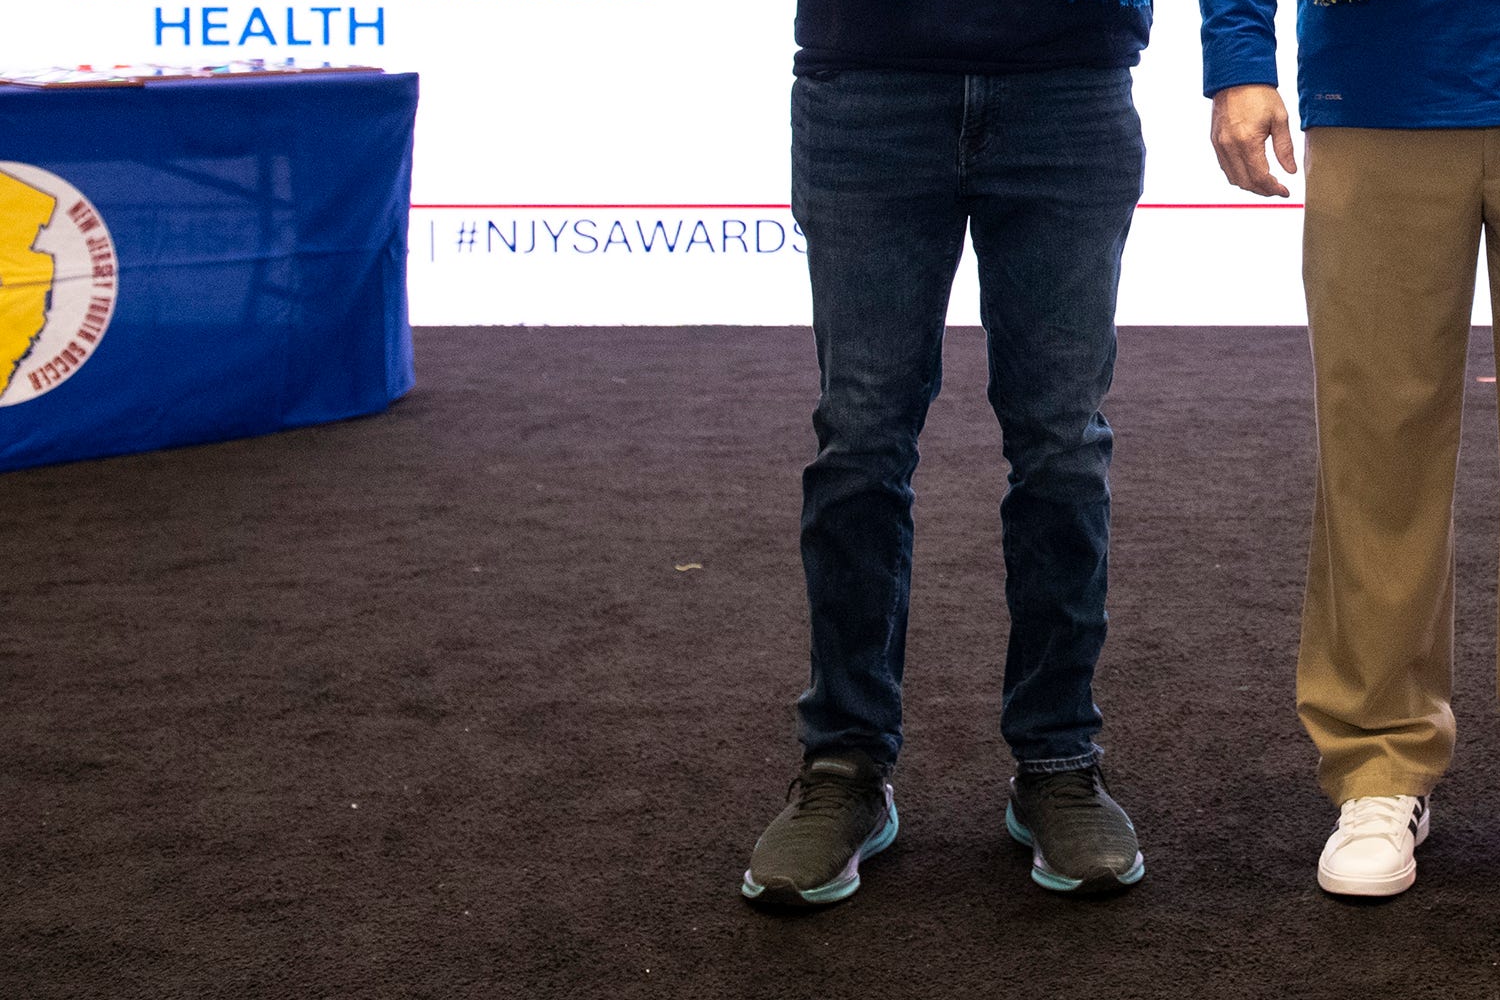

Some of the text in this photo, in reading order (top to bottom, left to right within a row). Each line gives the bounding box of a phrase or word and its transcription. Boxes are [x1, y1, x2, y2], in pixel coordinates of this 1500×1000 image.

[155, 6, 386, 46] HEALTH
[28, 200, 114, 391] NEW JERSEY YOUTH SOCCER
